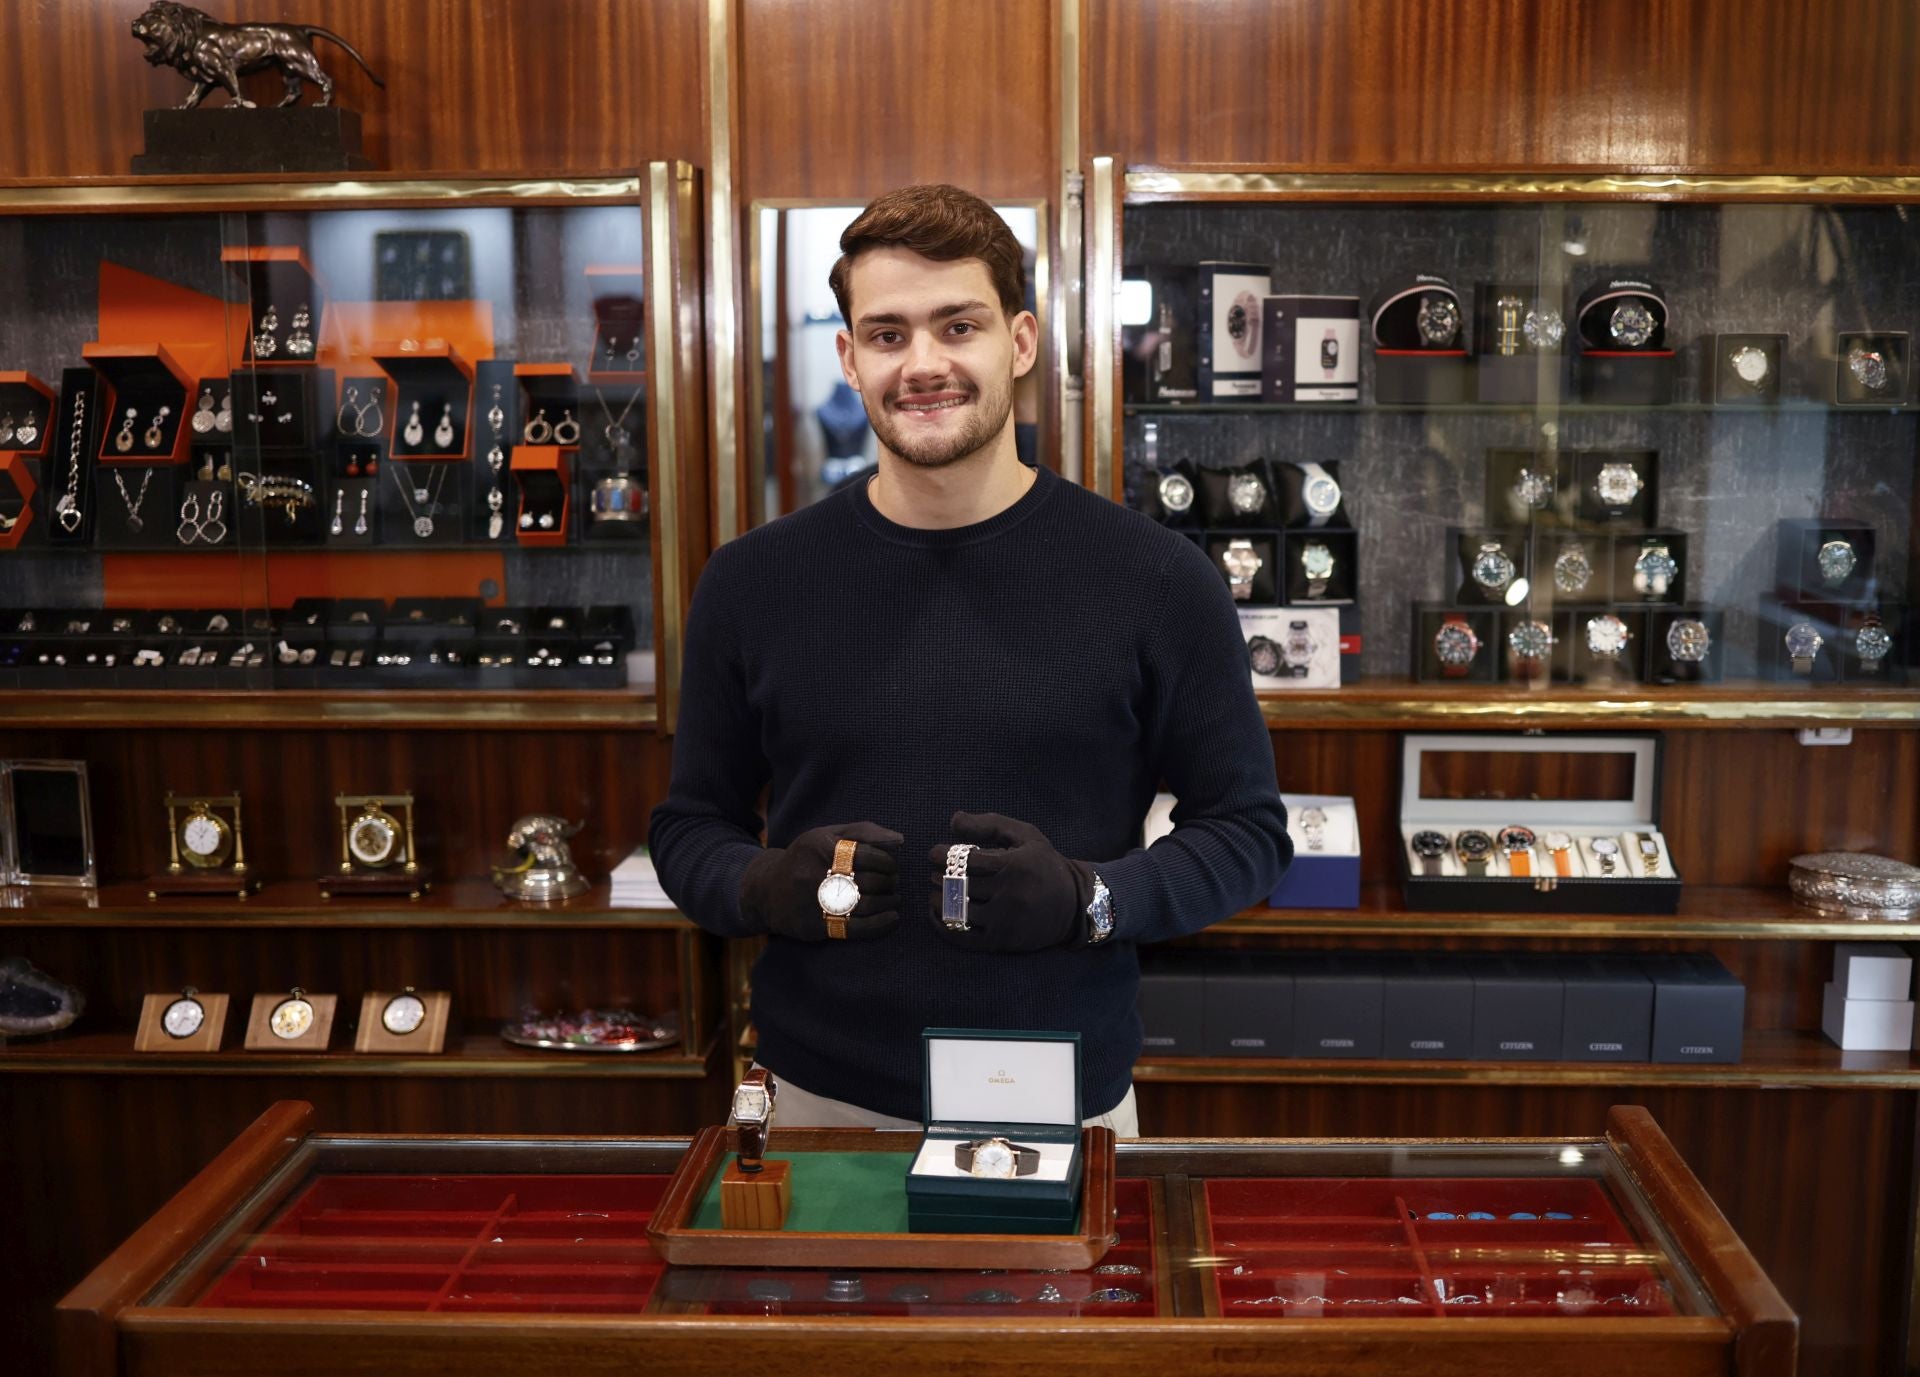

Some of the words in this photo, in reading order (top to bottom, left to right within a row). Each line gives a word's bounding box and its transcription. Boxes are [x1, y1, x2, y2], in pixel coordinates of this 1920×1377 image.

[1320, 1039, 1355, 1048] CITIZEN
[1410, 1040, 1444, 1049] CITIZEN
[1500, 1042, 1534, 1050] CITIZEN
[1589, 1043, 1623, 1051] CITIZEN
[1680, 1046, 1714, 1054] CITIZEN
